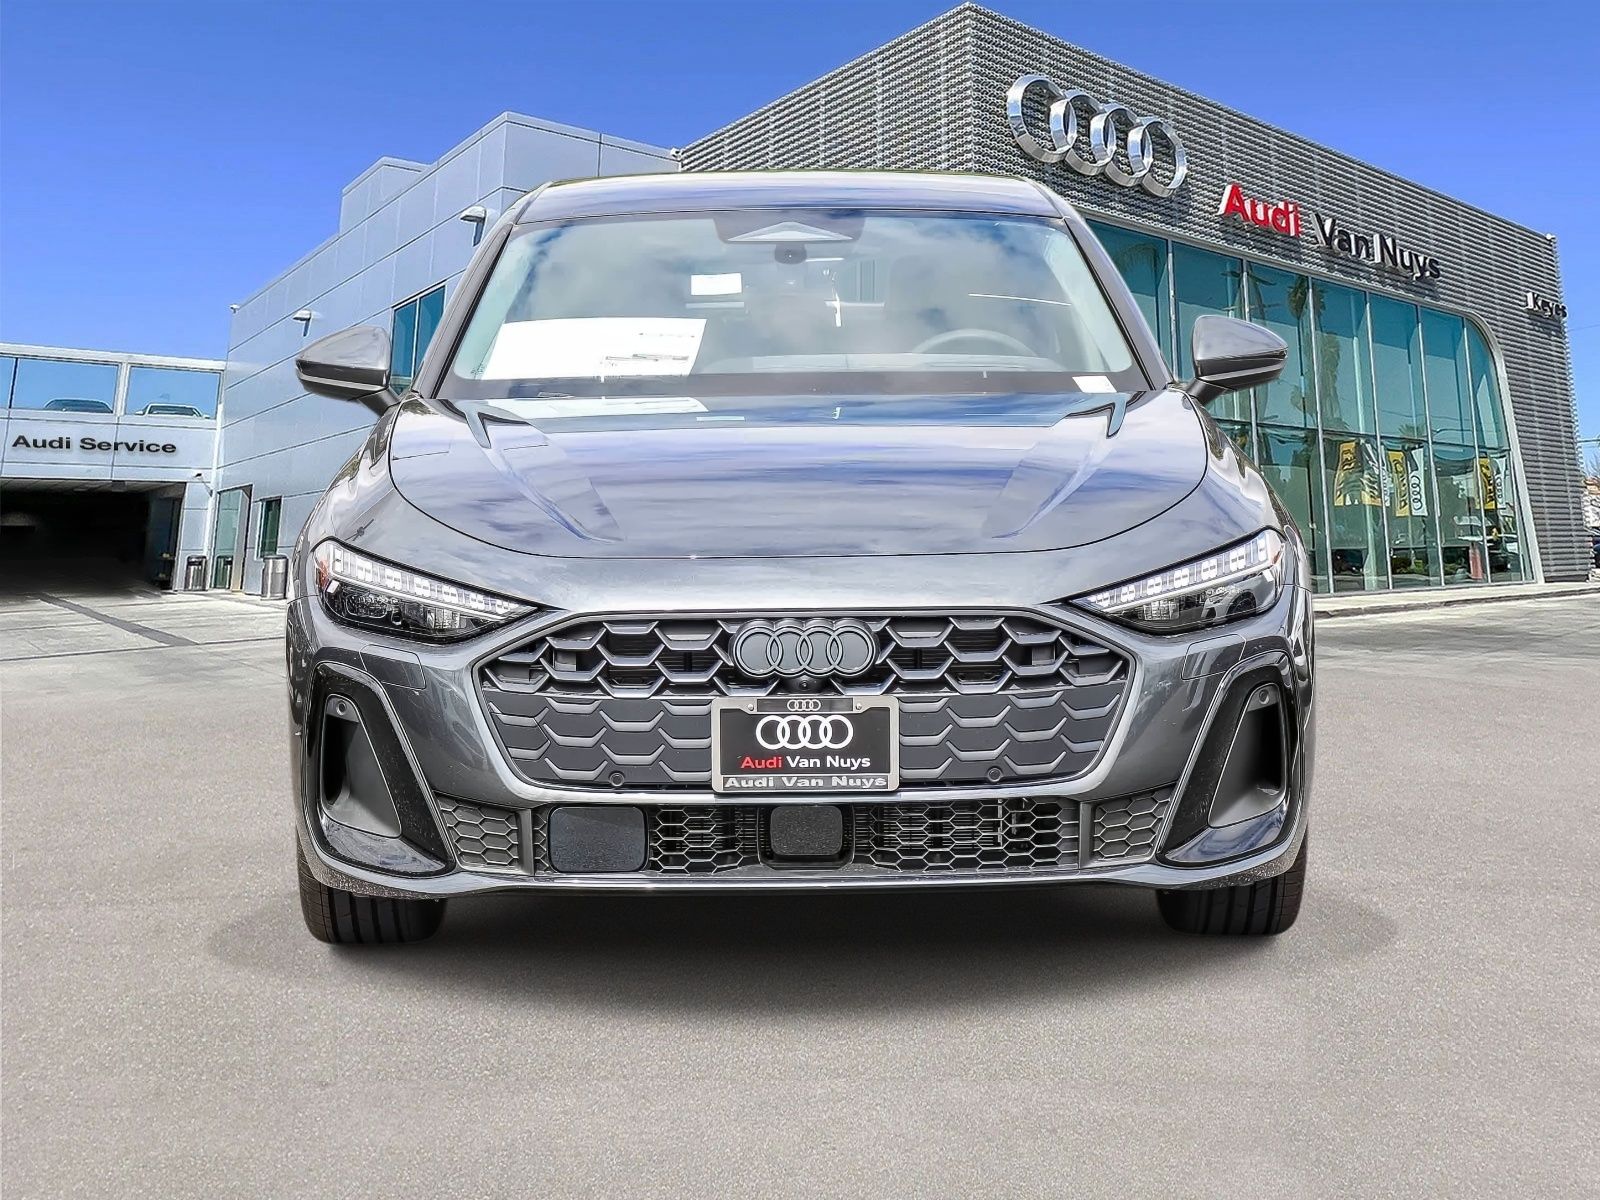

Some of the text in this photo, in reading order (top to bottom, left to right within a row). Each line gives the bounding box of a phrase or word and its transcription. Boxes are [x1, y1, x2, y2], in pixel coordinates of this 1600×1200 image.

[1217, 182, 1441, 281] Audi Van Nuys
[1525, 291, 1568, 318] Keyes
[12, 434, 177, 453] Audi Service
[740, 755, 871, 770] Audi Van Nuys
[724, 776, 888, 789] Audi Van Nuys
